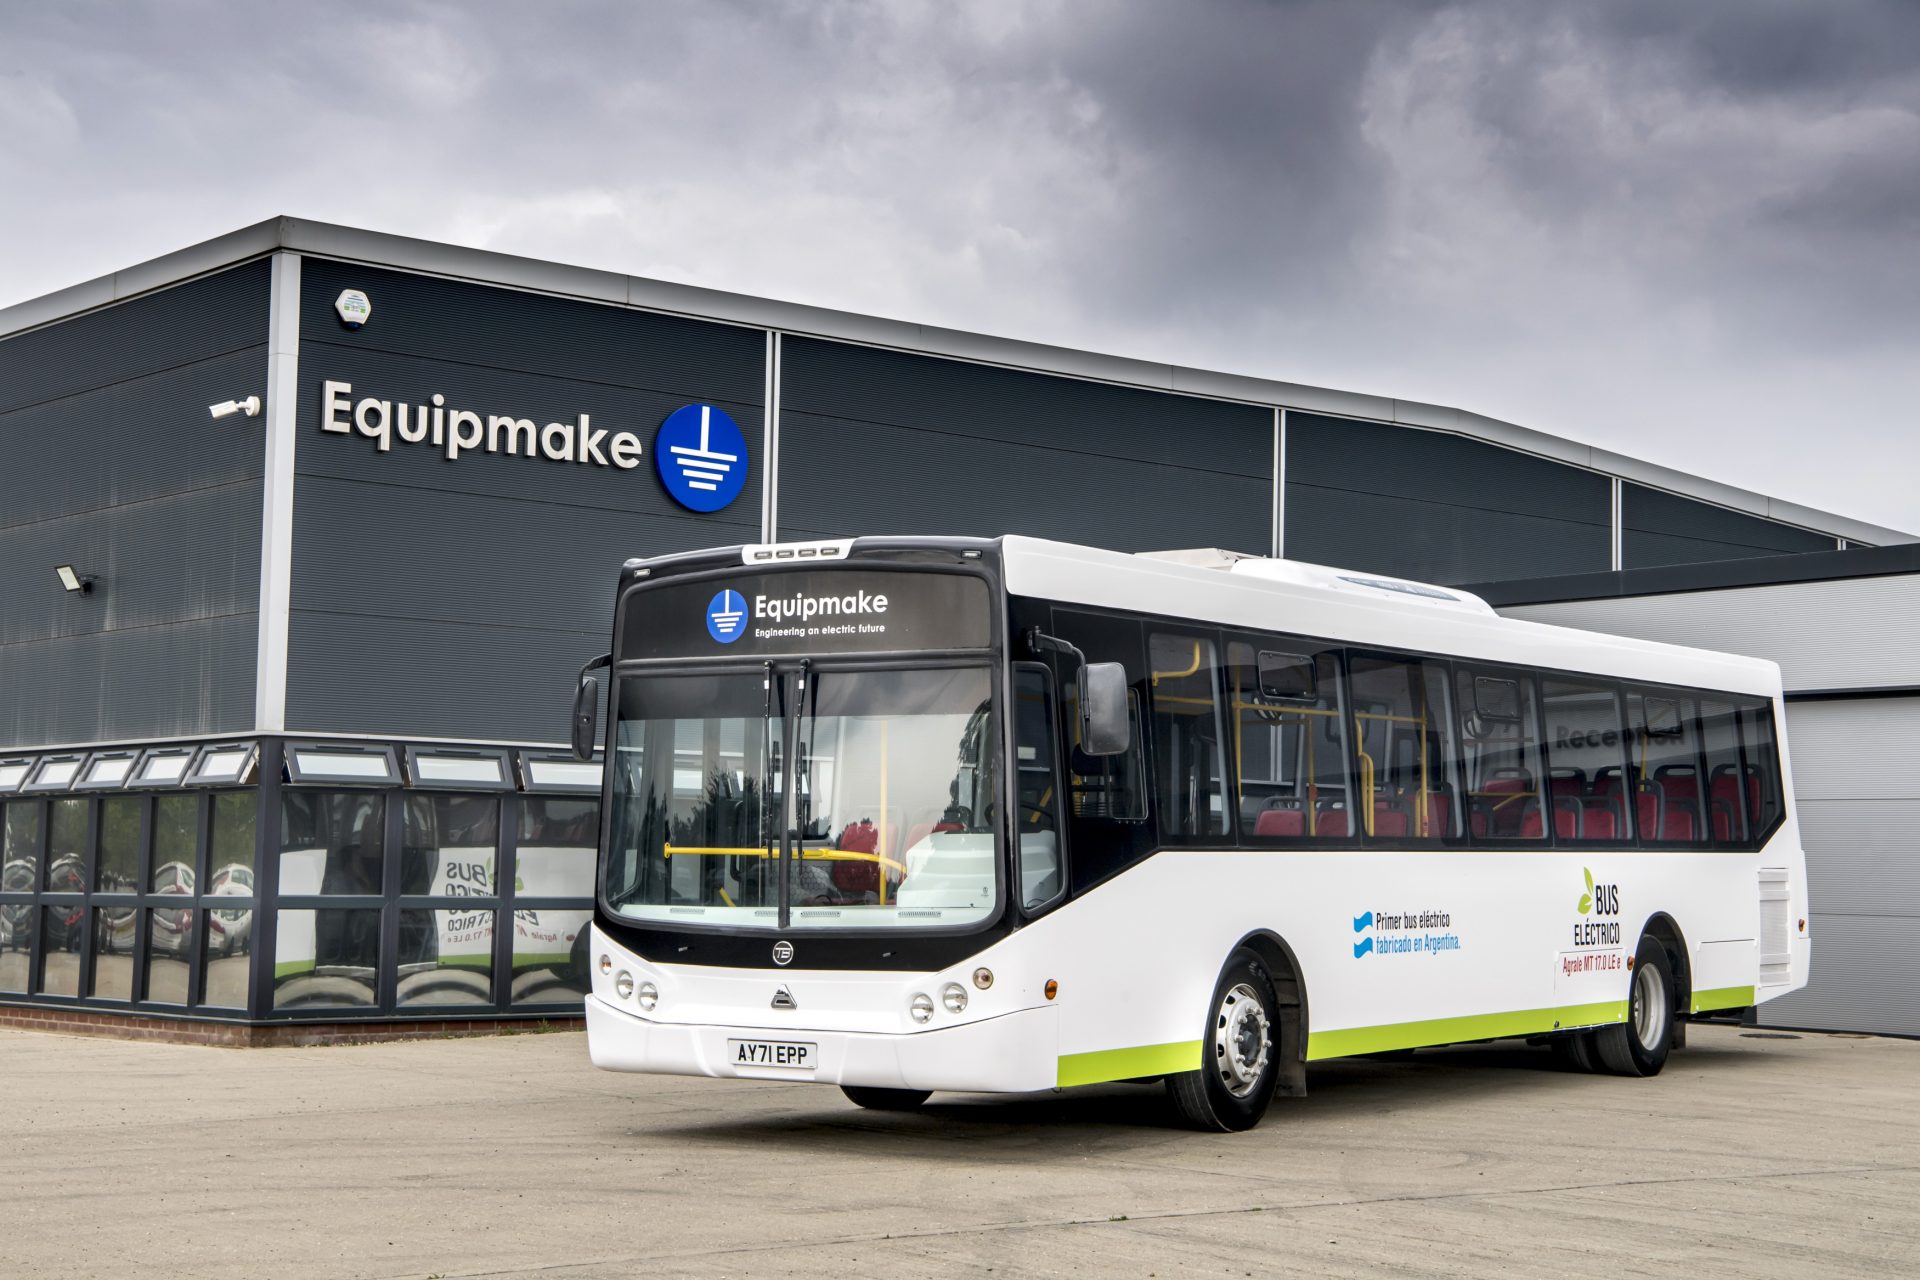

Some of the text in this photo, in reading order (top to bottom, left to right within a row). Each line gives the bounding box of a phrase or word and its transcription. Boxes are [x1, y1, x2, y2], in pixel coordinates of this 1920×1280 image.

[321, 380, 643, 469] Equipmake
[755, 589, 889, 622] Equipmake
[755, 623, 886, 638] Engineering an electric future
[1596, 884, 1619, 915] BUS
[1376, 910, 1450, 930] Primer bus eléctrico
[1574, 918, 1620, 945] ELÉCTRICO
[1376, 933, 1461, 955] fabricado en Argentina.
[1563, 954, 1621, 977] Agrale MT 17.0 LE e
[738, 1043, 807, 1064] AY71 EPP
